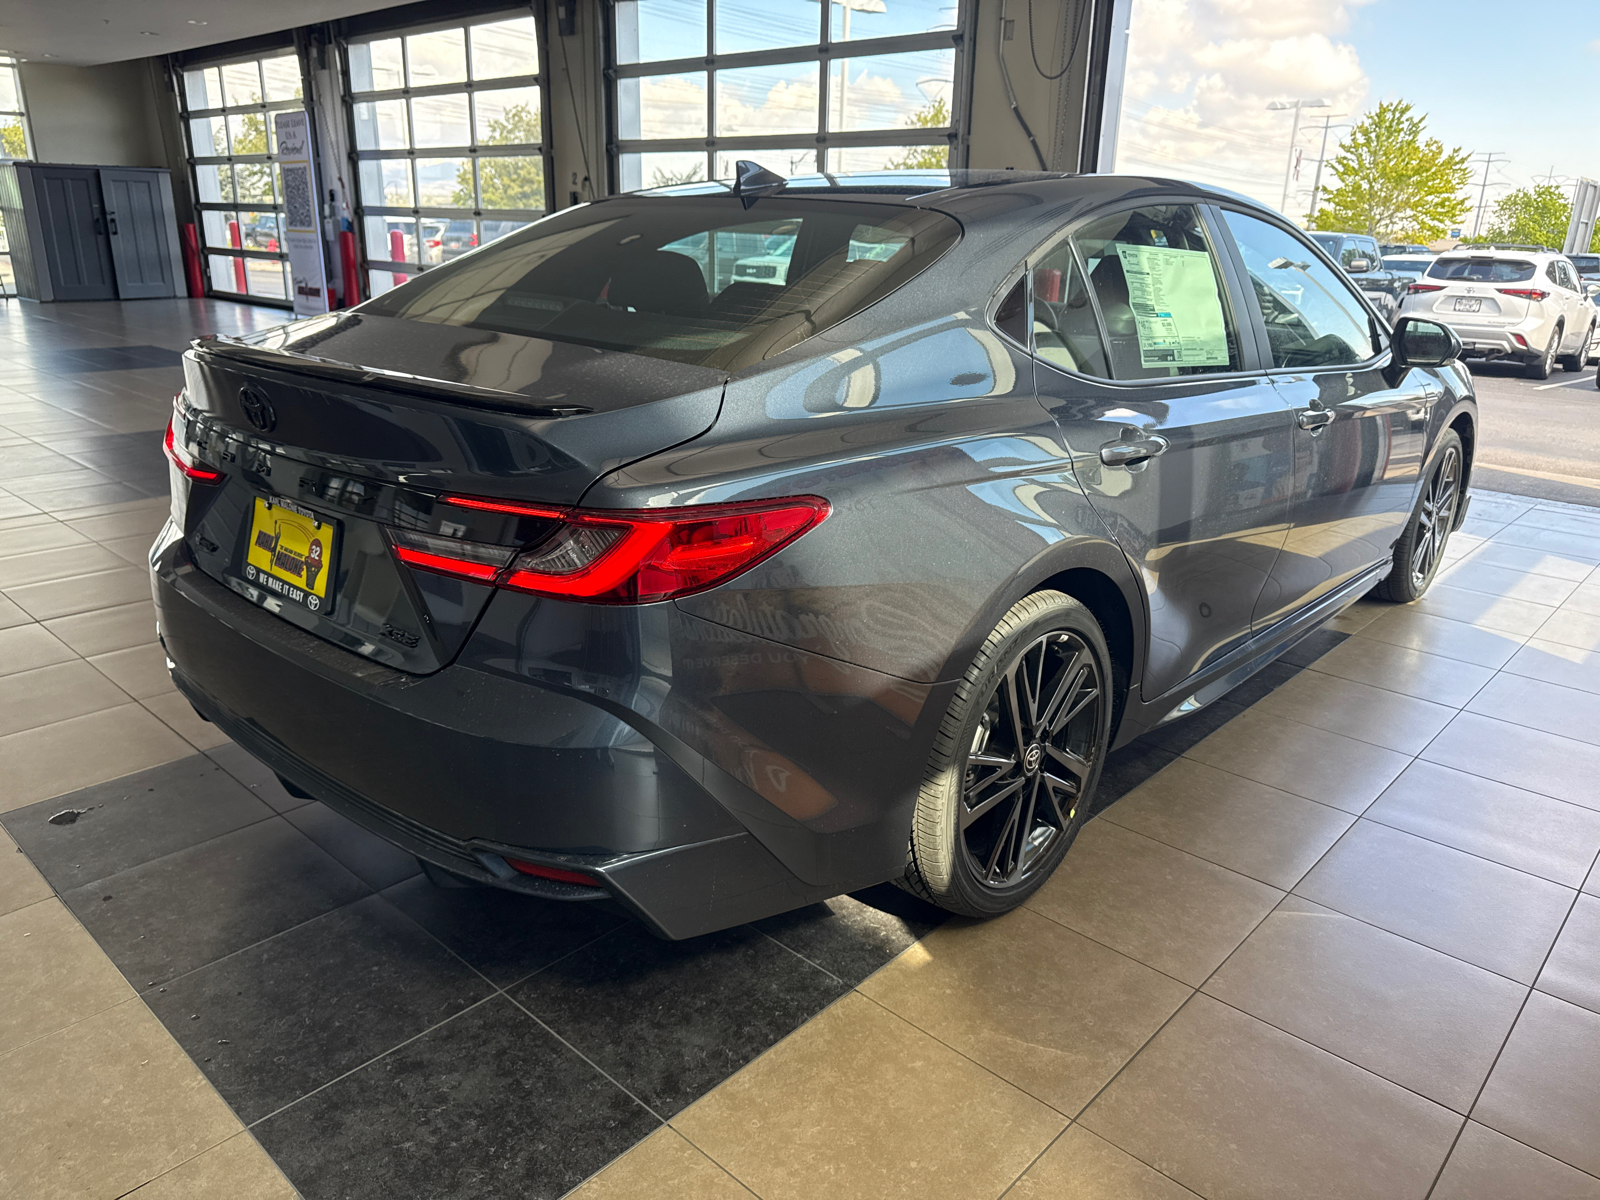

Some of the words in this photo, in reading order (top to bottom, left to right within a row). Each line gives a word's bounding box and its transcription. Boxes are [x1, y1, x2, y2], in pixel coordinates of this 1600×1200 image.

[274, 550, 305, 578] MALONE
[310, 545, 320, 560] 32
[259, 572, 268, 585] WE
[268, 577, 283, 593] MAKE
[283, 584, 289, 595] IT
[289, 587, 304, 602] EASY
